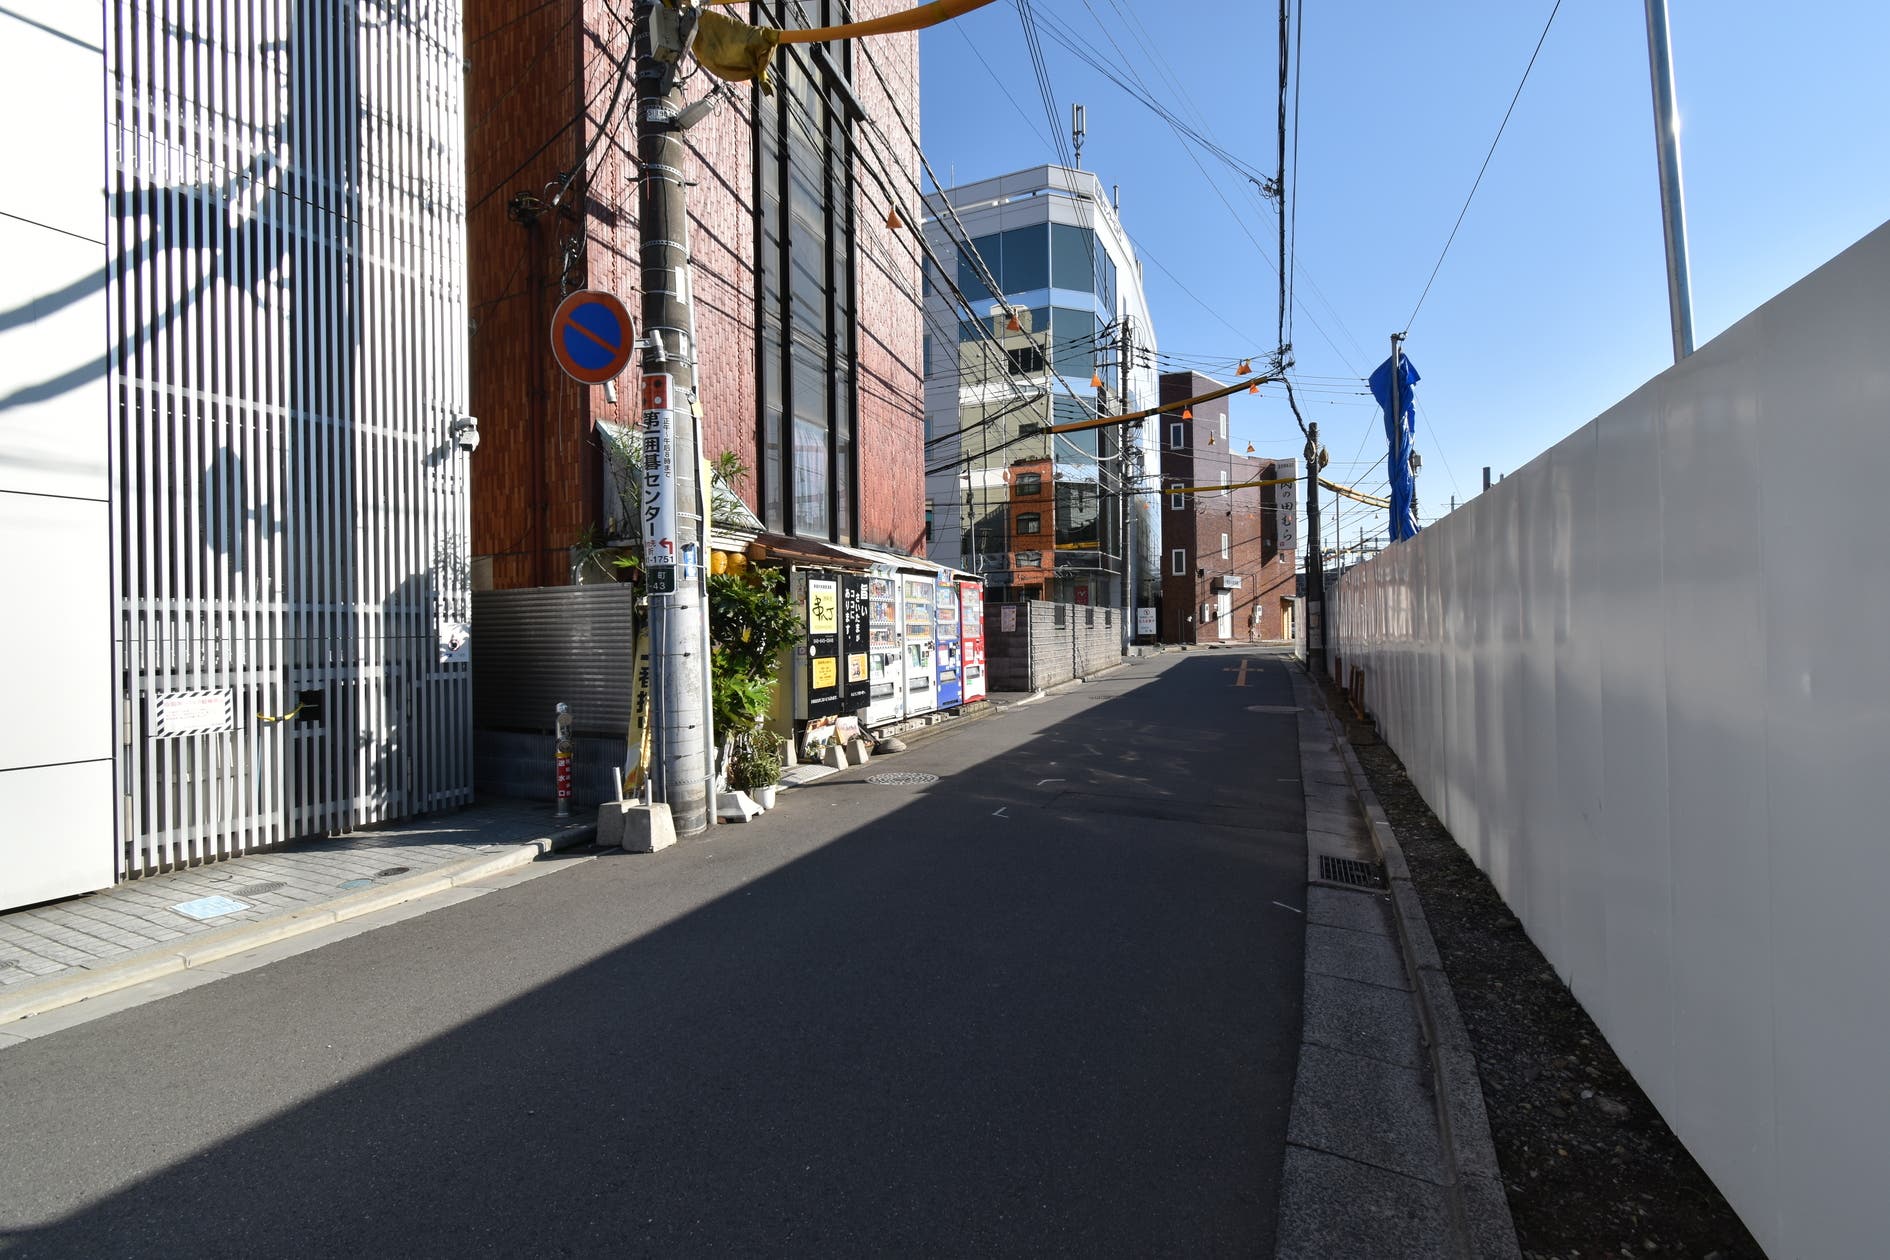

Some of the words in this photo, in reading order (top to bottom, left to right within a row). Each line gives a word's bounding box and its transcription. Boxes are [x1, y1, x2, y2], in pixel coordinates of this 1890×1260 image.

[643, 411, 661, 537] 第一囲碁センター
[861, 584, 868, 617] 旨い
